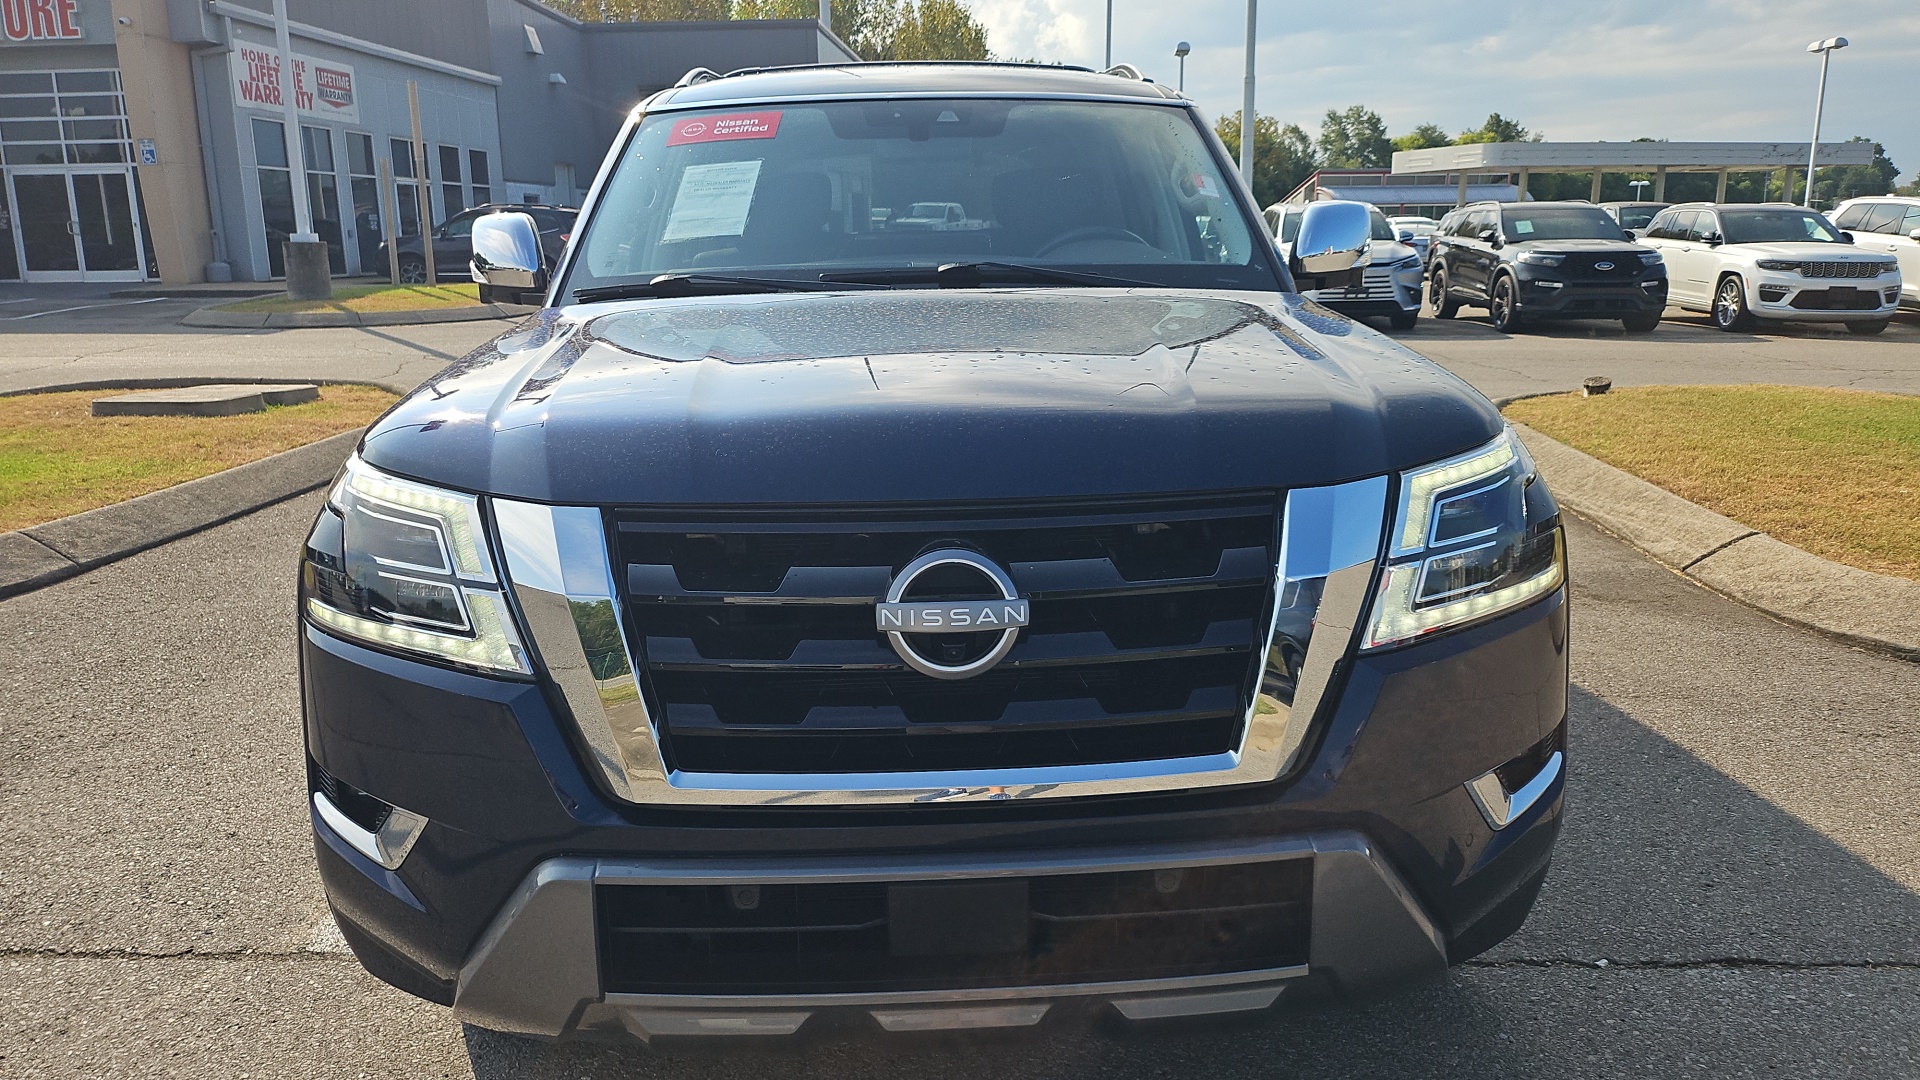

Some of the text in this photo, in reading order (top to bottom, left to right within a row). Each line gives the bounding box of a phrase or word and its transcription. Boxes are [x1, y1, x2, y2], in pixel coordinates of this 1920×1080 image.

[241, 47, 270, 67] HOME
[247, 62, 304, 91] LIFETE
[316, 71, 350, 89] LIFETIME
[239, 79, 314, 111] WARRTY
[317, 86, 353, 103] WARRANTY
[713, 124, 769, 135] Certified
[716, 118, 759, 128] Nissan
[881, 605, 1025, 627] NISSAN
